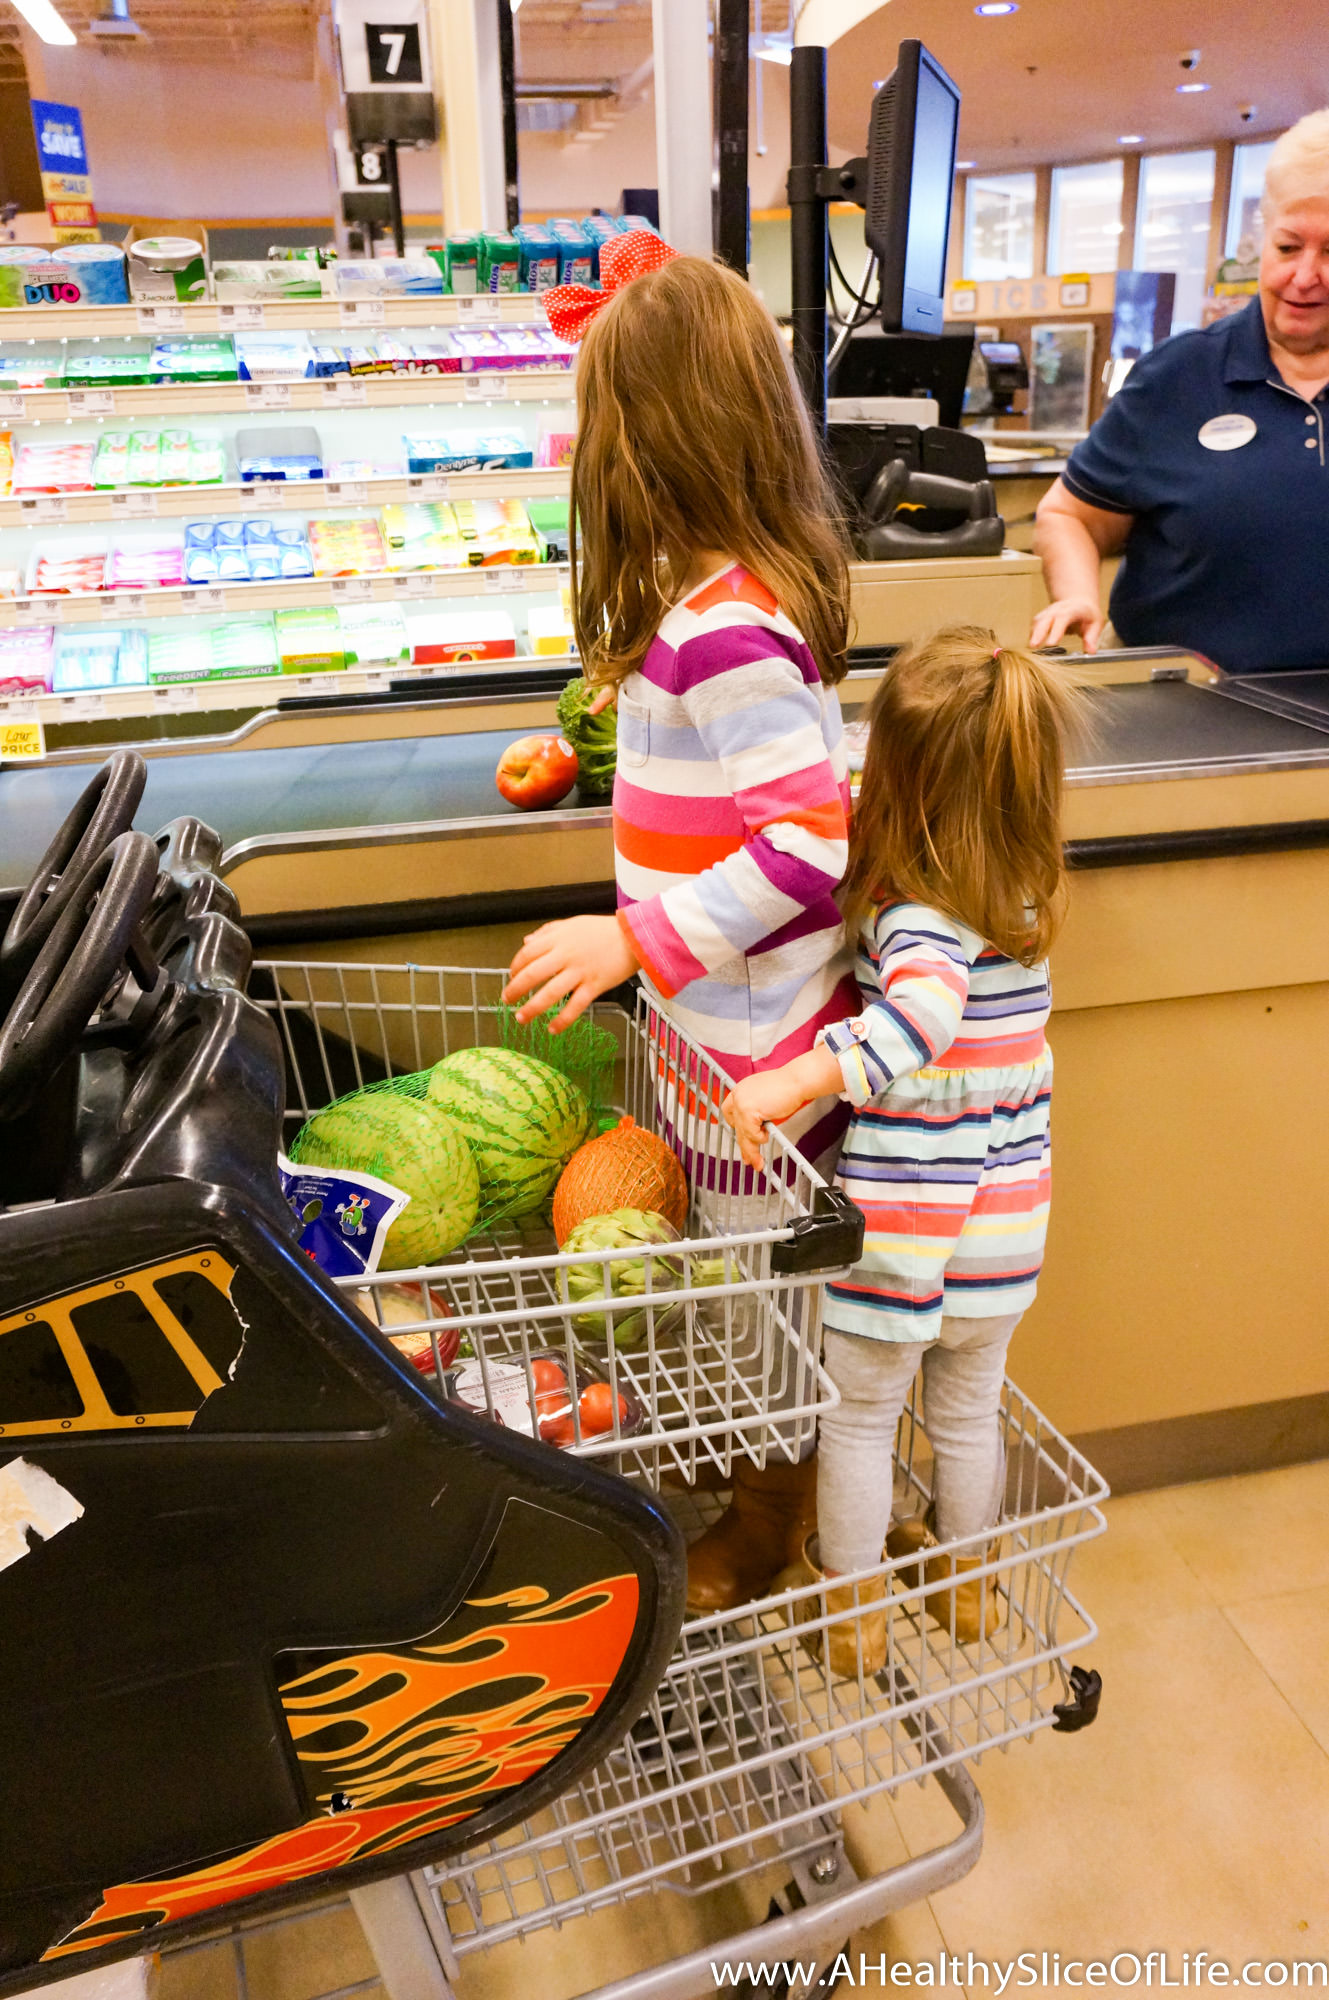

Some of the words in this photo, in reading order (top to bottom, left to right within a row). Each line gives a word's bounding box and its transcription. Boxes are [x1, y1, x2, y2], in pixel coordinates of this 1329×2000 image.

[379, 33, 406, 75] 7
[361, 152, 382, 180] 8
[24, 283, 81, 304] DUO
[434, 457, 478, 472] Dentyne
